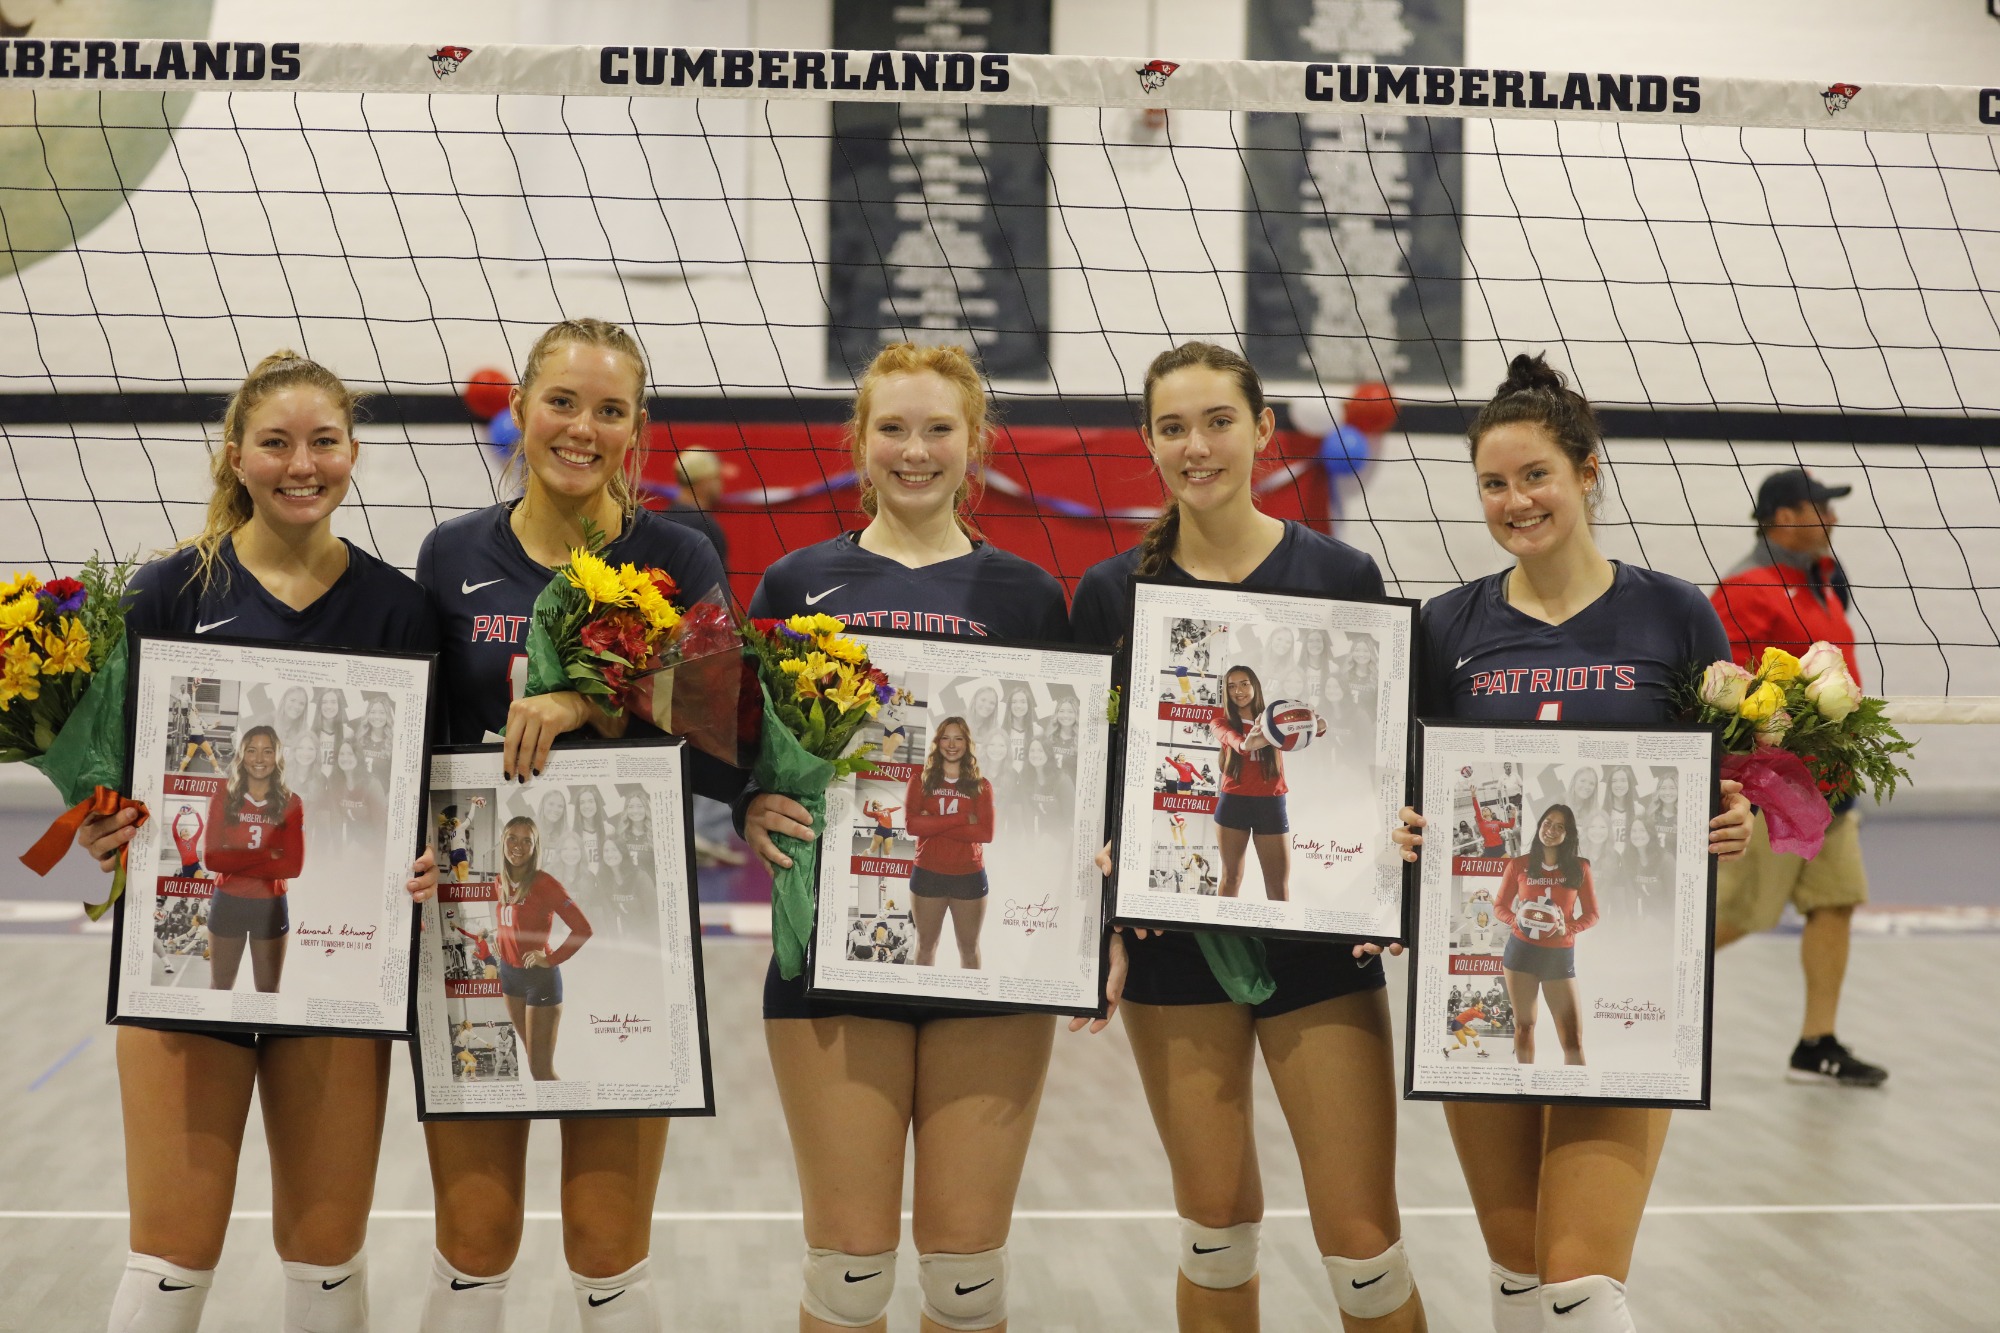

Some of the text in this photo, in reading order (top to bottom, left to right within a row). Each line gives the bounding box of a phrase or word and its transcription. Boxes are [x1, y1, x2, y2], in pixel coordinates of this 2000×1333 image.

[0, 41, 300, 81] BERLANDS
[601, 46, 1010, 92] CUMBERLANDS
[1305, 63, 1700, 114] CUMBERLANDS
[471, 614, 533, 643] PAT
[1470, 664, 1636, 696] PATRIOTS
[1170, 706, 1213, 720] PATRIOTS
[173, 778, 218, 793] PATRIOTS
[938, 797, 959, 816] 14
[1162, 797, 1210, 811] VOLLEYBALL
[247, 825, 263, 850] 3
[861, 860, 909, 876] VOLLEYBALL
[1460, 860, 1504, 873] PATRIOTS
[163, 880, 213, 896] VOLLEYBALL
[450, 886, 491, 898] PATRIOTS
[500, 905, 513, 927] 10
[300, 939, 320, 947] LIBERTY
[1454, 959, 1503, 972] VOLLEYBALL
[454, 982, 502, 995] VOLLEYBALL
[1593, 1011, 1633, 1020] JEFFERSONVILLE,
